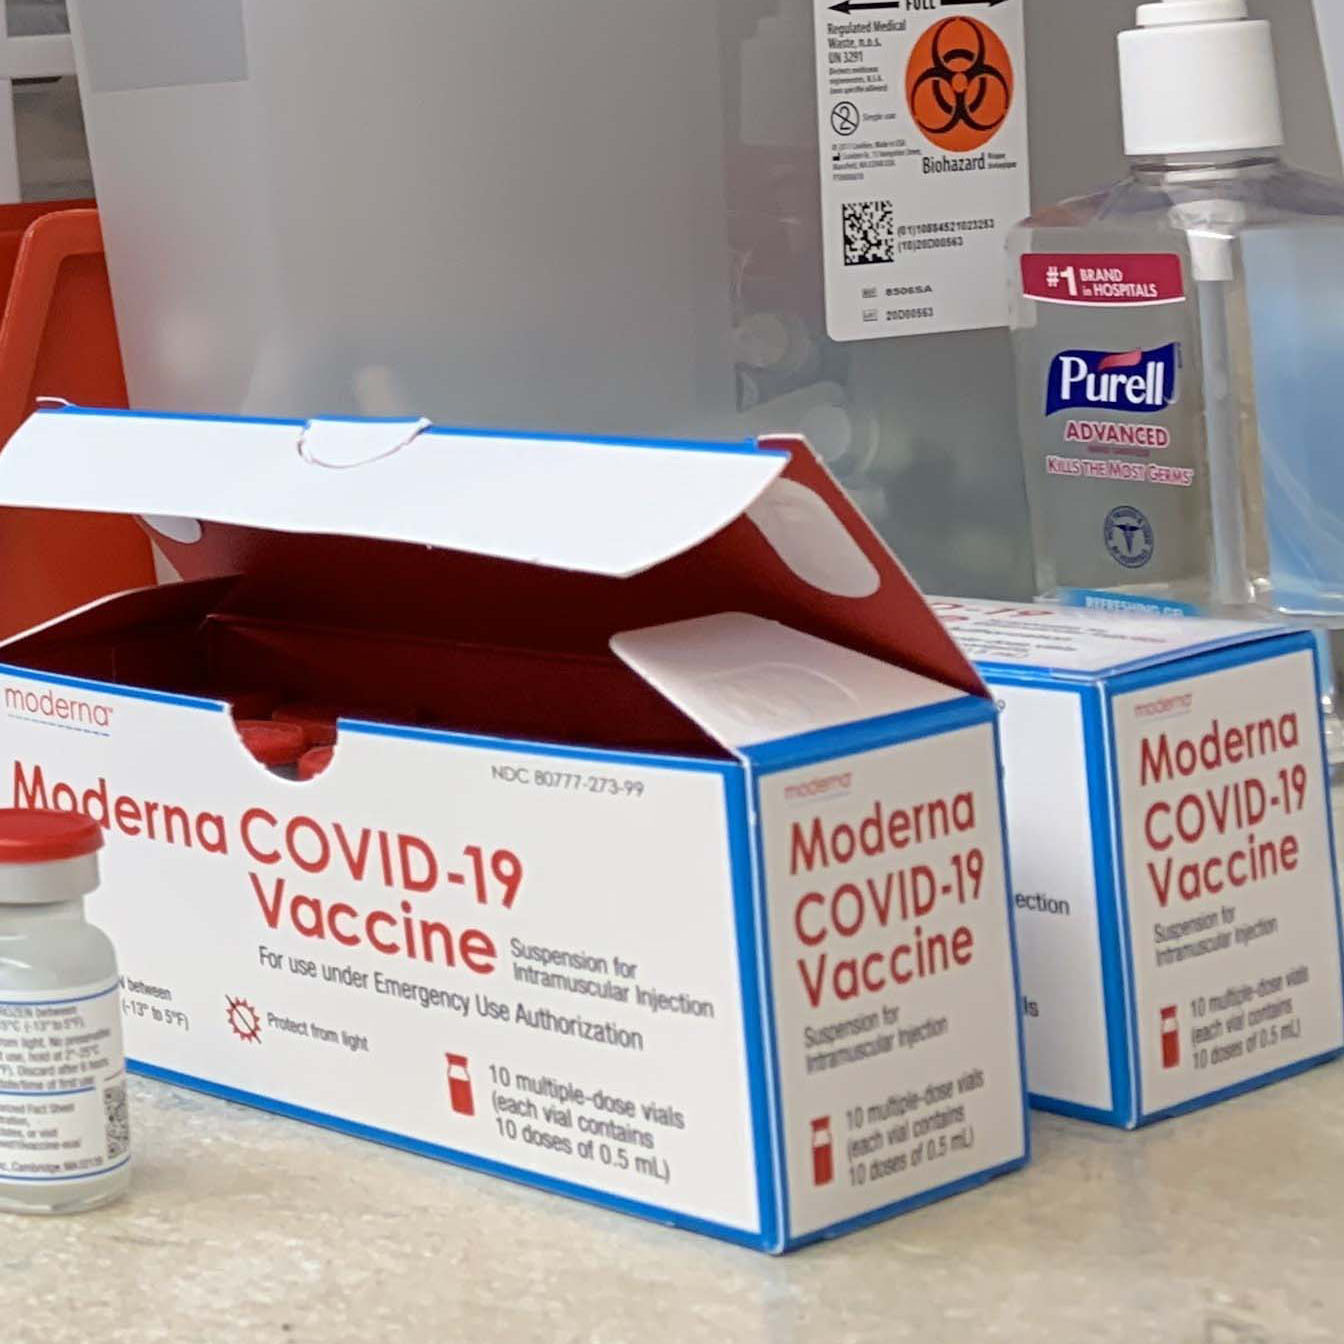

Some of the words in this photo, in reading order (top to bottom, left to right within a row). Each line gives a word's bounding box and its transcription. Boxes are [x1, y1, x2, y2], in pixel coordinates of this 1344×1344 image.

[827, 22, 872, 37] Regulated
[873, 19, 907, 32] Medical
[922, 152, 985, 174] Biohazard
[1046, 265, 1078, 297] #1
[1080, 268, 1123, 282] BRAND
[1082, 285, 1093, 296] in
[1094, 283, 1158, 298] HOSPITALS
[1058, 355, 1165, 406] Purell
[1066, 421, 1169, 447] ADVANCED
[1047, 457, 1080, 474] KILLS
[1083, 460, 1106, 477] THE
[1109, 462, 1146, 481] MOST
[3, 686, 111, 728] moderna
[1140, 712, 1299, 786] Moderna
[491, 765, 529, 787] NDC
[534, 769, 644, 799] 80777-273-99
[1144, 763, 1307, 852] COVID-19
[12, 759, 229, 855] Moderna
[239, 807, 524, 909] COVID-19
[789, 791, 976, 876] Moderna
[794, 847, 984, 947] COVID-19
[1146, 833, 1299, 909] Vaccine
[248, 871, 498, 974] Vaccine
[1014, 892, 1071, 916] ection
[510, 937, 608, 974] Suspension
[612, 955, 637, 978] for
[797, 924, 974, 1008] Vaccine
[258, 945, 284, 969] For
[288, 956, 318, 978] use
[322, 958, 369, 990] under
[374, 972, 471, 1018] Emergency
[475, 994, 511, 1022] Use
[515, 1003, 644, 1050] Authorization
[512, 962, 630, 1003] Intramuscular
[634, 984, 715, 1019] Injection
[1191, 996, 1207, 1018] 10
[267, 1012, 309, 1037] Protect
[310, 1023, 340, 1045] from
[340, 1030, 370, 1054] light
[804, 1011, 880, 1048] Suspension
[882, 1004, 900, 1026] for
[805, 1032, 895, 1075] Intramuscular
[897, 1015, 949, 1049] Injection
[1193, 1048, 1208, 1070] 10
[1210, 1040, 1244, 1066] doses
[1259, 1025, 1279, 1049] 0.5
[488, 1063, 512, 1087] 10
[515, 1071, 636, 1119] multiple-dose
[640, 1101, 686, 1130] vials
[491, 1089, 538, 1120] (each
[542, 1103, 572, 1129] vial
[577, 1113, 655, 1150] contains
[846, 1106, 864, 1130] 10
[867, 1080, 954, 1124] multiple-dose
[956, 1067, 985, 1095] vials
[495, 1115, 518, 1140] 10
[522, 1123, 573, 1156] doses
[577, 1140, 595, 1161] of
[599, 1143, 630, 1170] 0.5
[634, 1157, 671, 1185] mL)
[847, 1133, 884, 1164] (each
[886, 1124, 910, 1146] vial
[912, 1105, 966, 1138] contains
[848, 1162, 866, 1186] 10
[869, 1152, 907, 1182] doses
[910, 1142, 924, 1167] of
[926, 1136, 948, 1162] 0.5
[950, 1125, 975, 1152] mL)
